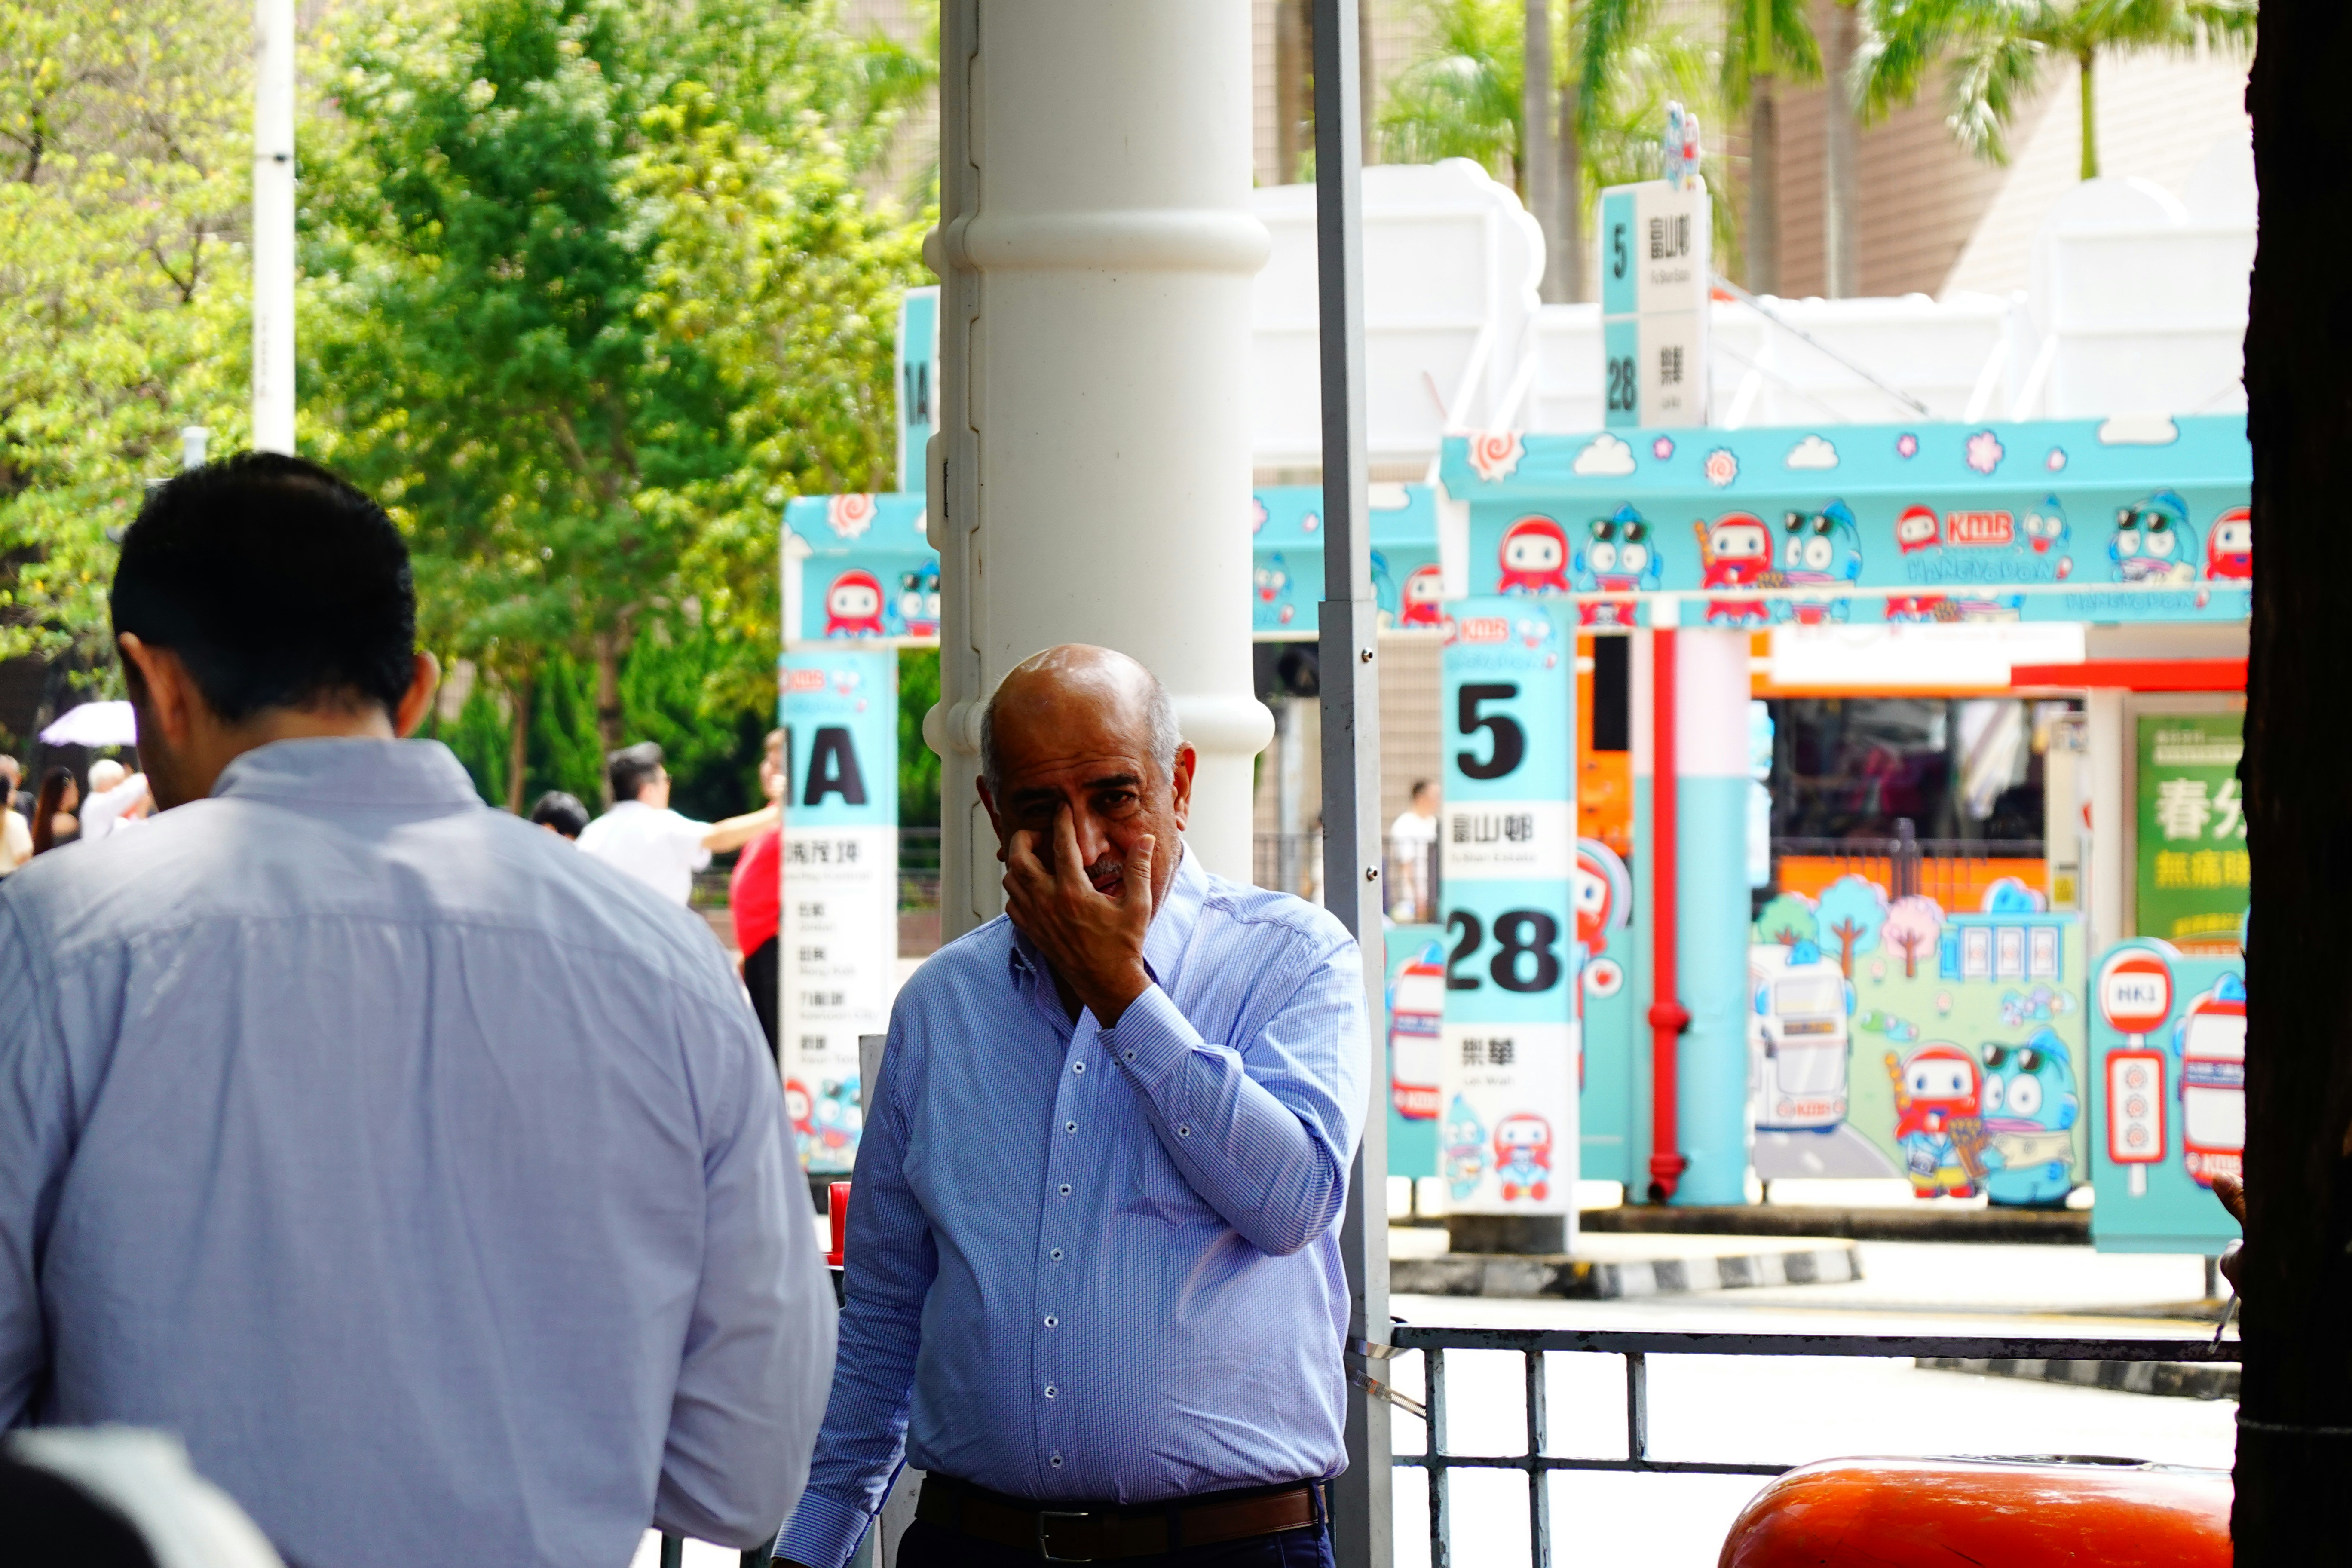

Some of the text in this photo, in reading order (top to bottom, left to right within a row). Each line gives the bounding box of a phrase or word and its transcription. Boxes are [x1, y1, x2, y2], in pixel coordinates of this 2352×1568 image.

[1612, 223, 1628, 279] 5
[1609, 356, 1638, 411] 28
[1948, 512, 2013, 544] KMB
[1457, 683, 1526, 780] 5
[1446, 908, 1562, 993] 28
[2116, 984, 2156, 1003] HK1
